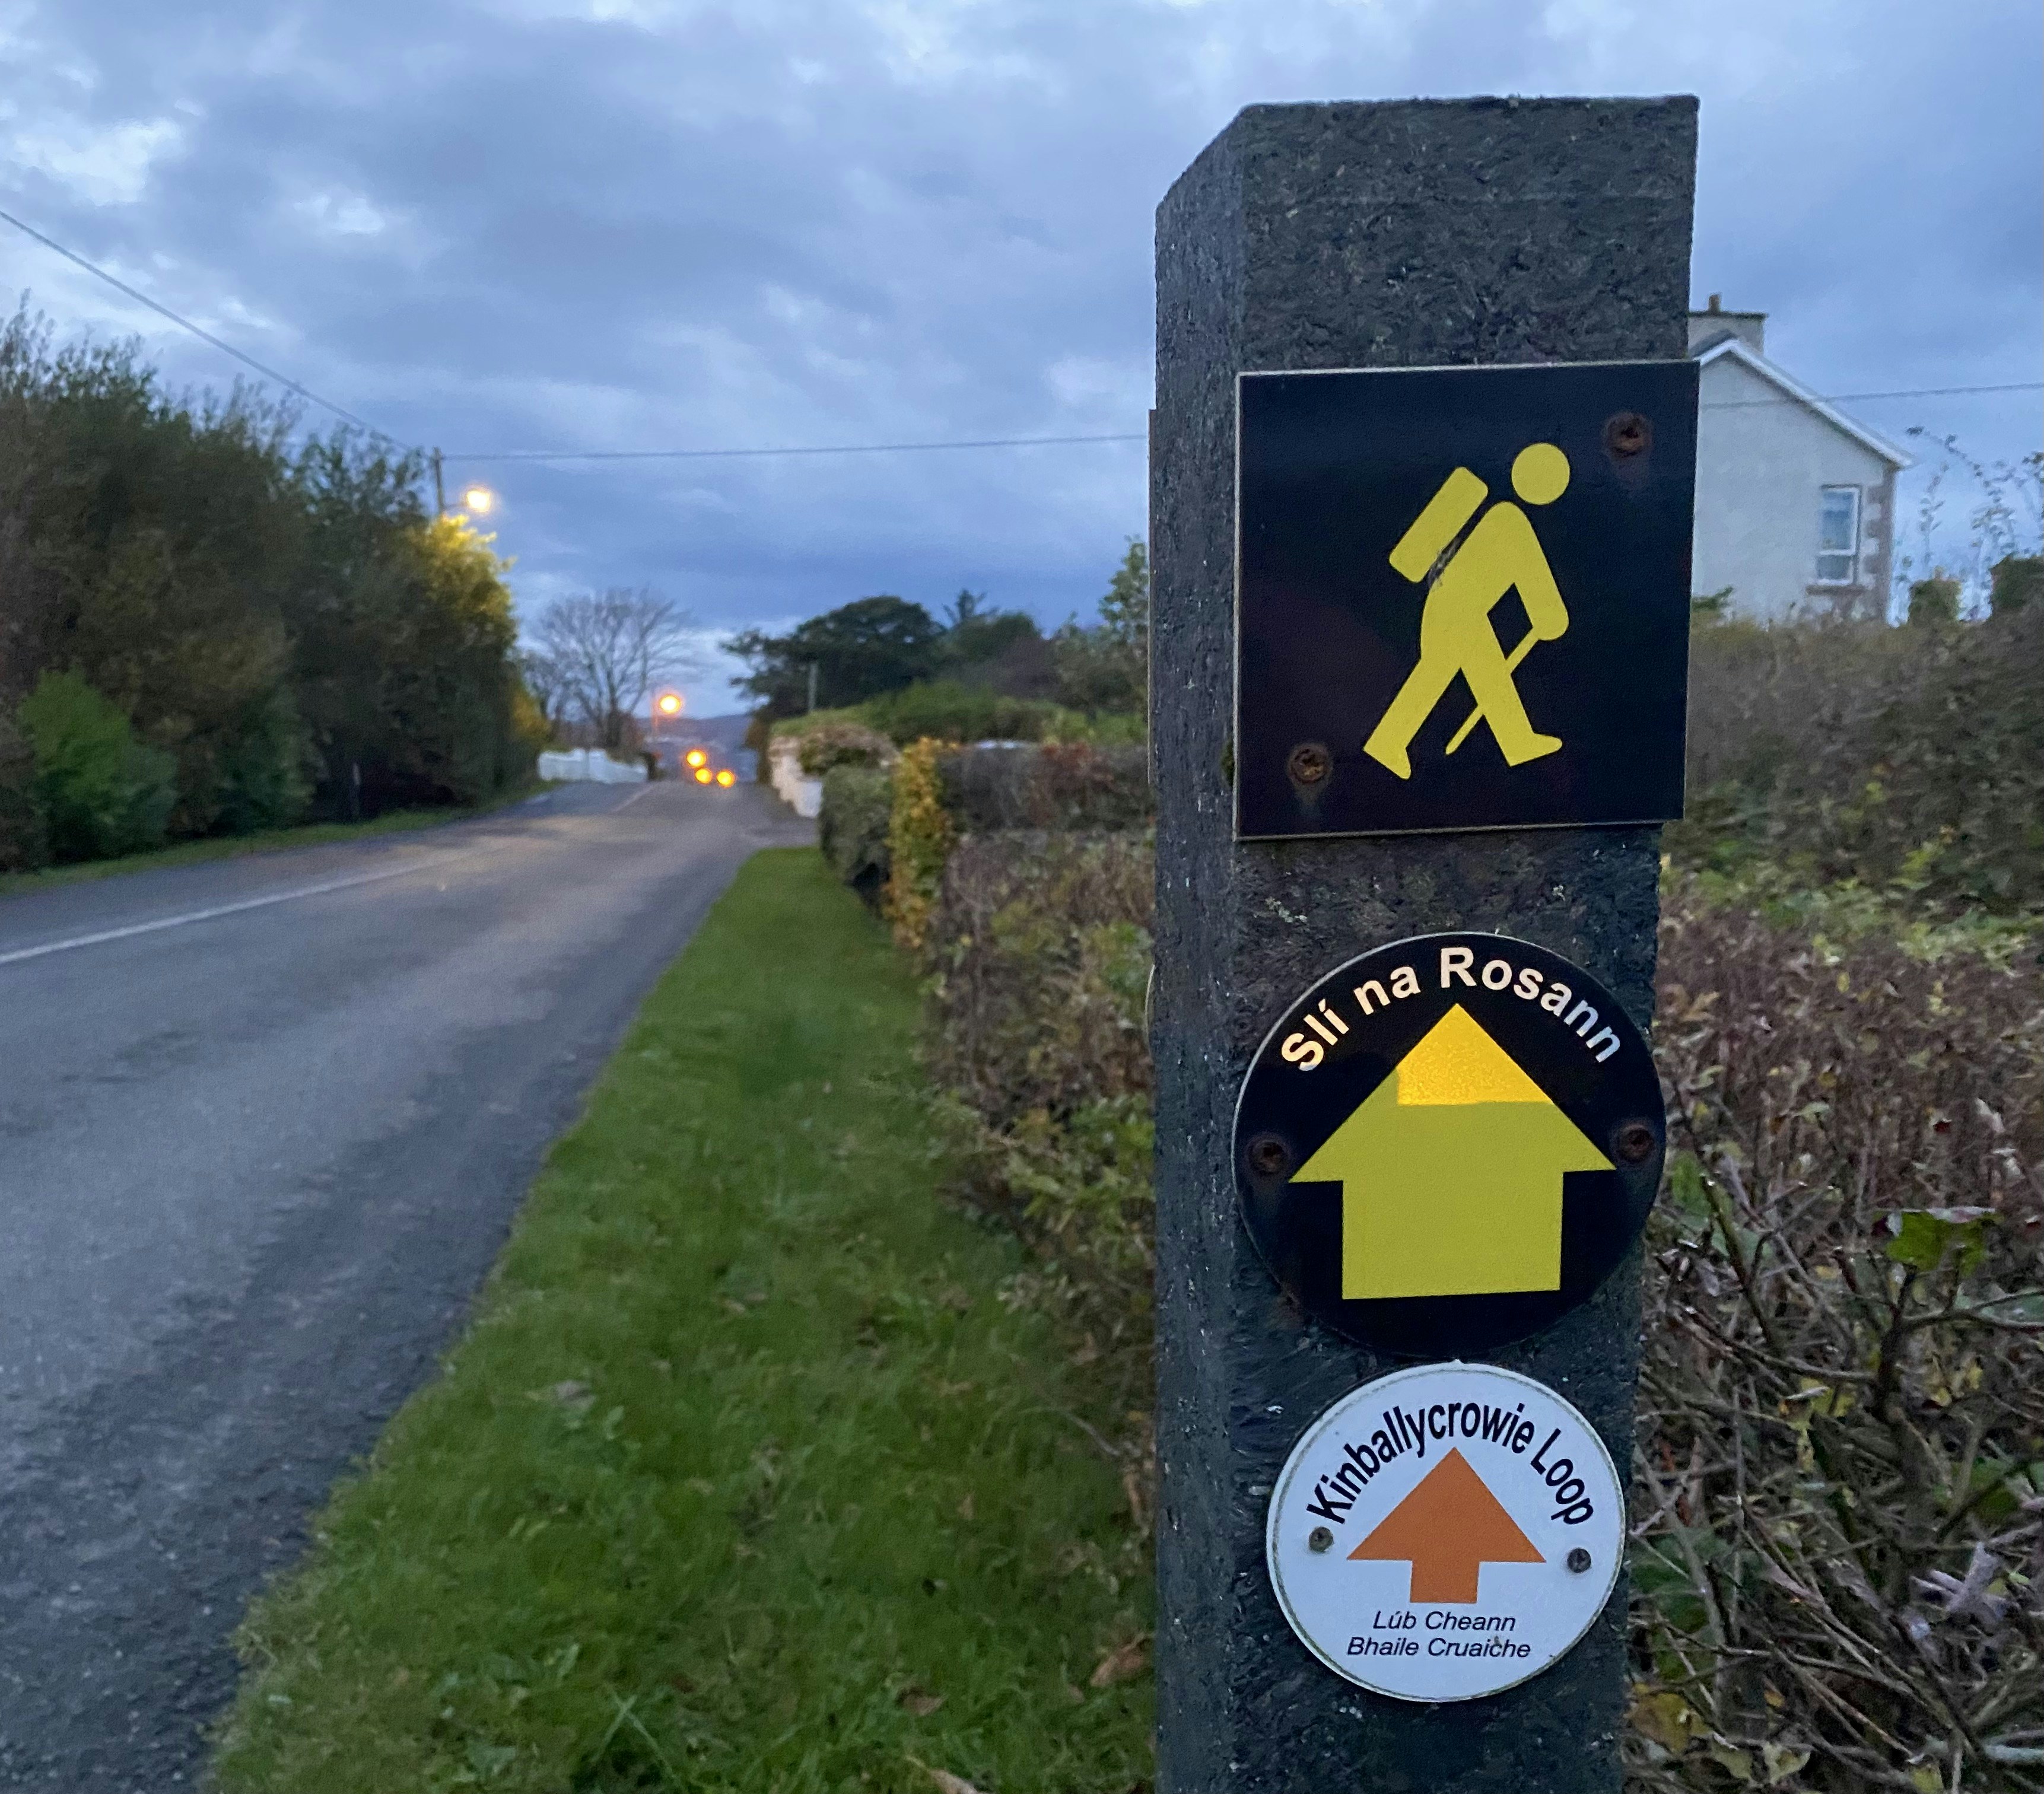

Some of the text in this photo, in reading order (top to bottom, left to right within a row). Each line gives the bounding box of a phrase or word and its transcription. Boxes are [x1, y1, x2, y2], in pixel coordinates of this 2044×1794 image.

[1281, 946, 1621, 1071] Slí na Rosann
[1306, 1402, 1594, 1526] Kinballycrowie Loop
[1346, 1636, 1531, 1658] Bhaile Cruaiche
[1372, 1609, 1517, 1631] Lúb Cheann
